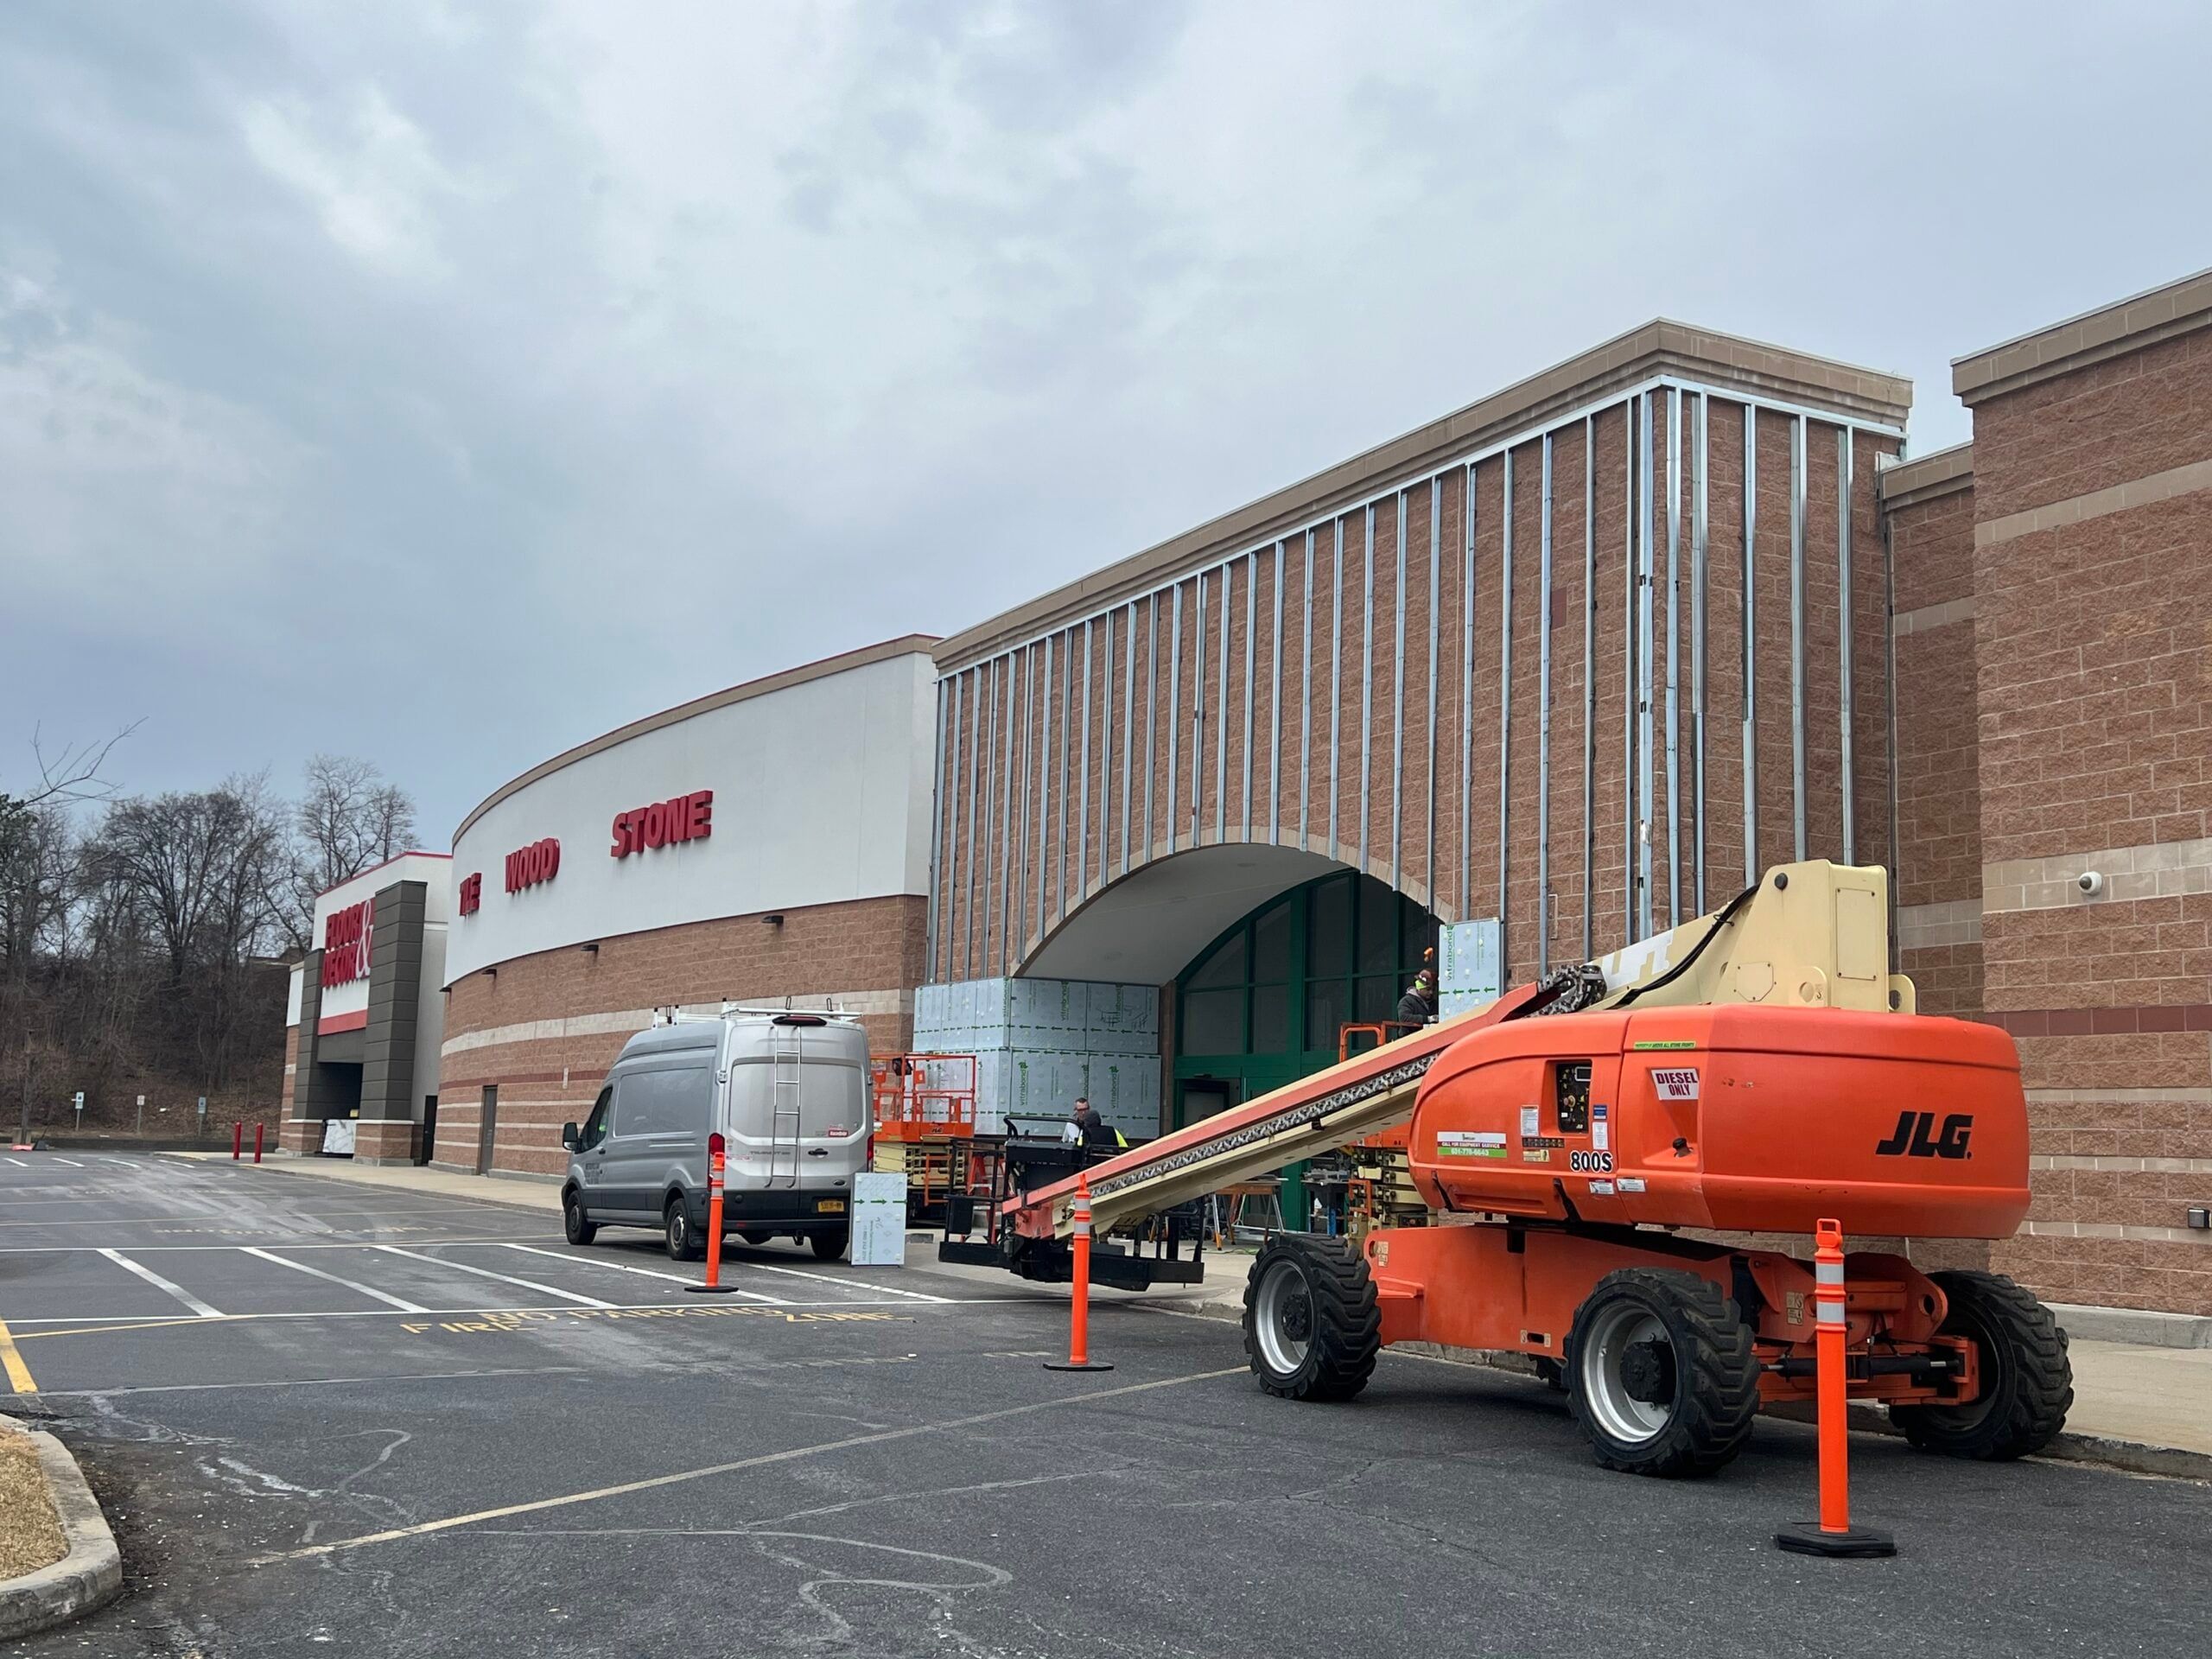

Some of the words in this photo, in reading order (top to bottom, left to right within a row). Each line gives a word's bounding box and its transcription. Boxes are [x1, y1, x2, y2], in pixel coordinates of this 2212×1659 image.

[611, 790, 713, 858] STONE
[505, 837, 560, 893] WOOD
[1656, 1072, 1698, 1084] DIESEL
[1669, 1084, 1691, 1096] ONLY
[1876, 1111, 1974, 1159] JLG
[1570, 1150, 1612, 1173] 800S
[479, 1312, 557, 1324] NO
[566, 1307, 787, 1319] PARKING
[399, 1321, 537, 1334] FIRE
